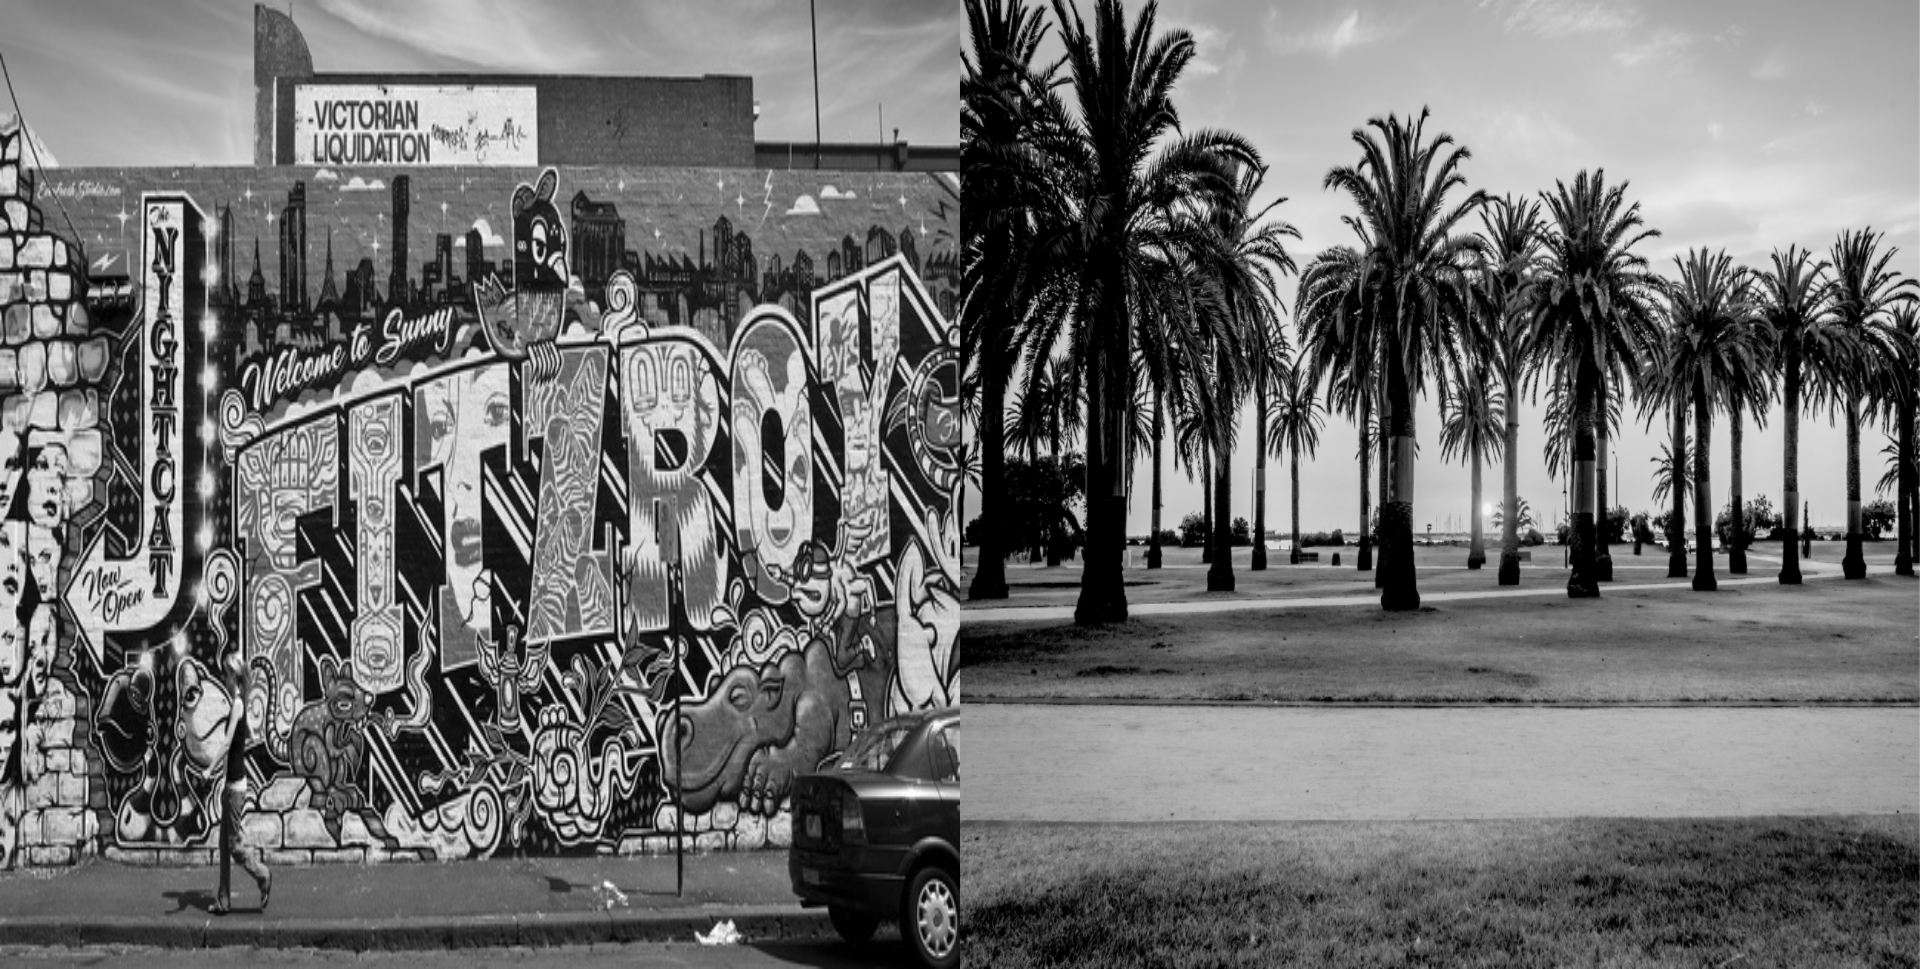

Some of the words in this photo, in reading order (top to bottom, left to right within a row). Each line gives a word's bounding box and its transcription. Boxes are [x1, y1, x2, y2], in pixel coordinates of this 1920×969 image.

[314, 100, 418, 131] VICTORIAN
[313, 132, 430, 164] LIQUIDATION
[241, 344, 346, 411] Welcome
[351, 322, 372, 363] to
[375, 306, 453, 364] Sunny
[236, 268, 900, 747] FITZROY
[82, 566, 122, 602] Now
[102, 587, 145, 624] Open
